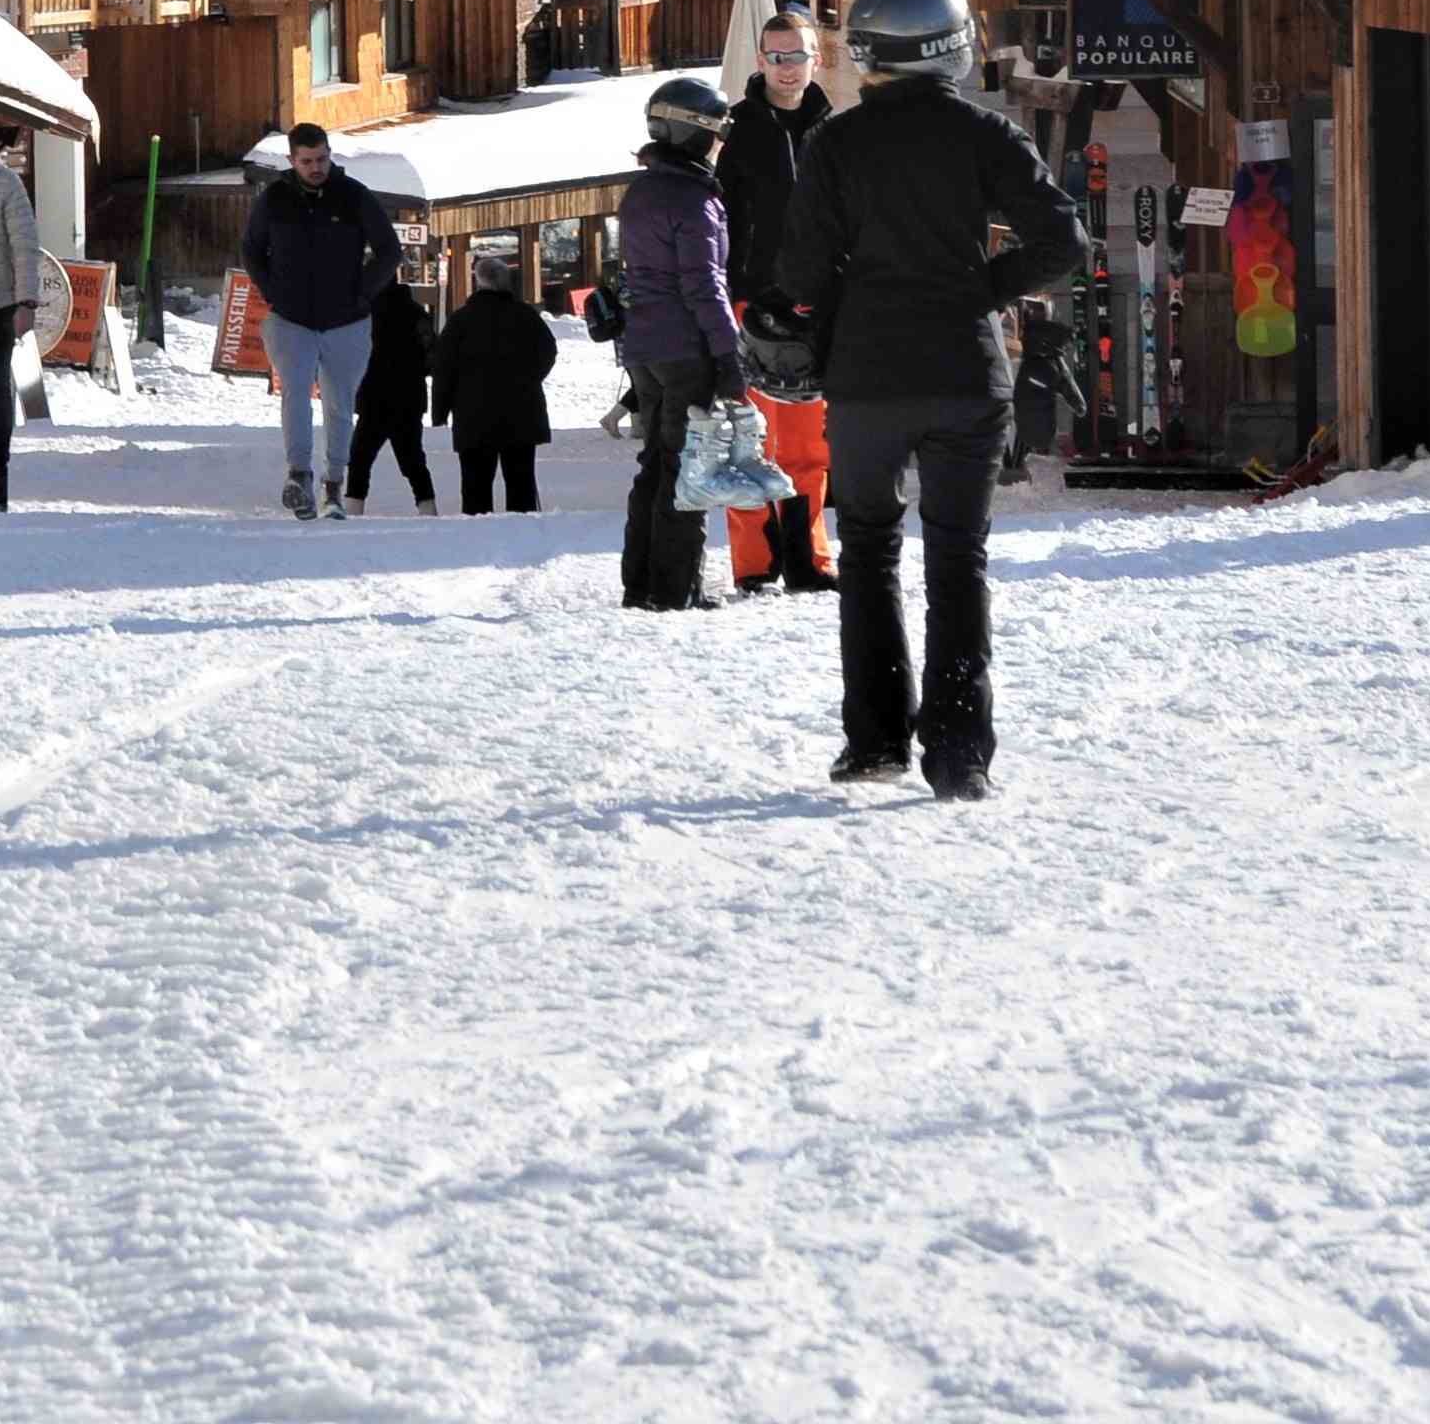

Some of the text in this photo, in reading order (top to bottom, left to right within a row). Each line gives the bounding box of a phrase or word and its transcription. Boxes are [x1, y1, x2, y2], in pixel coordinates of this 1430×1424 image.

[920, 29, 968, 58] uvex
[1076, 35, 1195, 48] BANQU
[1076, 51, 1196, 65] POPULAIRE
[1139, 196, 1154, 241] ROXY
[43, 277, 61, 290] RS
